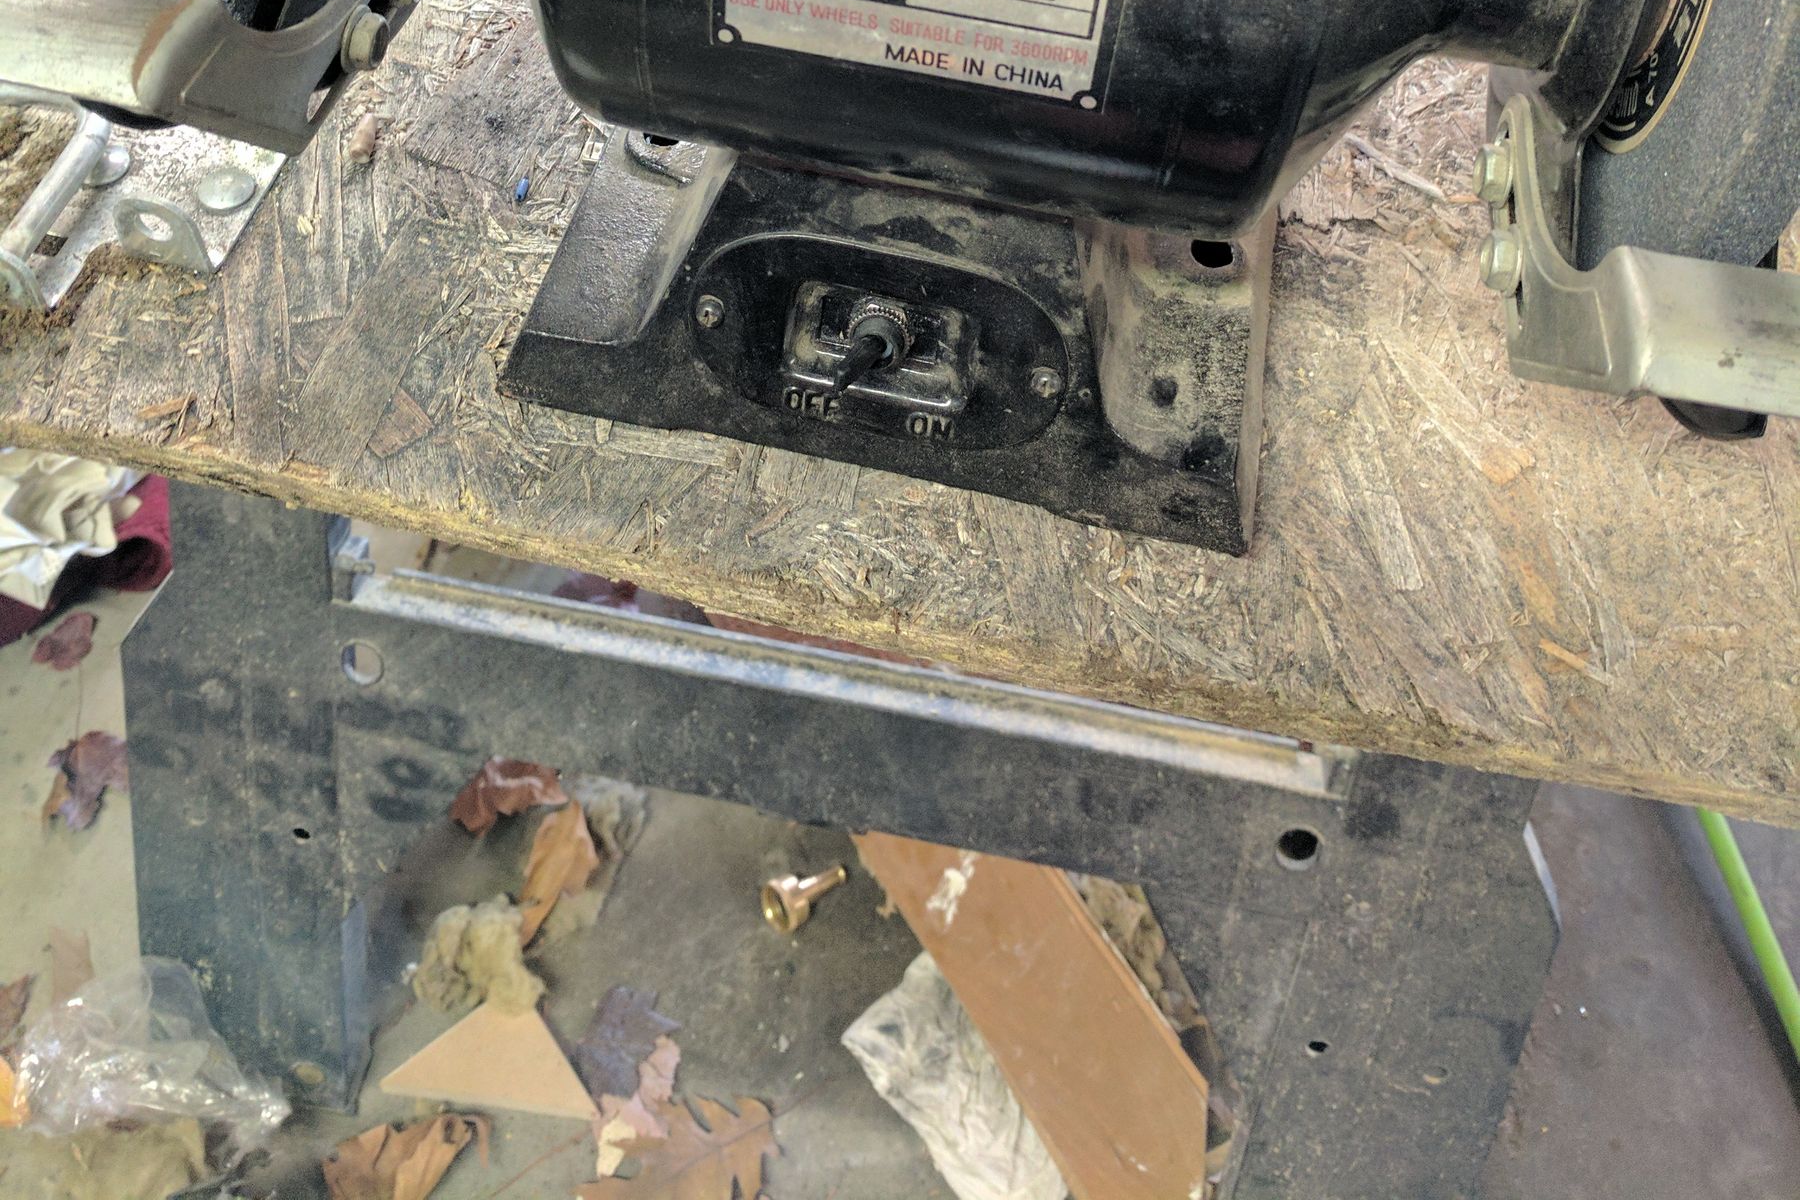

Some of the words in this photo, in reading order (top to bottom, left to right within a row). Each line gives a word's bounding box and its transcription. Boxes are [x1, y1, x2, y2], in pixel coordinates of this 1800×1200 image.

[810, 0, 878, 31] WHEELS
[889, 16, 966, 48] SUITABLE
[973, 32, 1005, 53] FOR
[1011, 40, 1089, 67] 3600RPM
[883, 43, 949, 71] MADE
[963, 56, 985, 77] IN
[995, 63, 1064, 92] CHINA
[783, 385, 842, 422] OFF
[906, 412, 955, 440] ON
